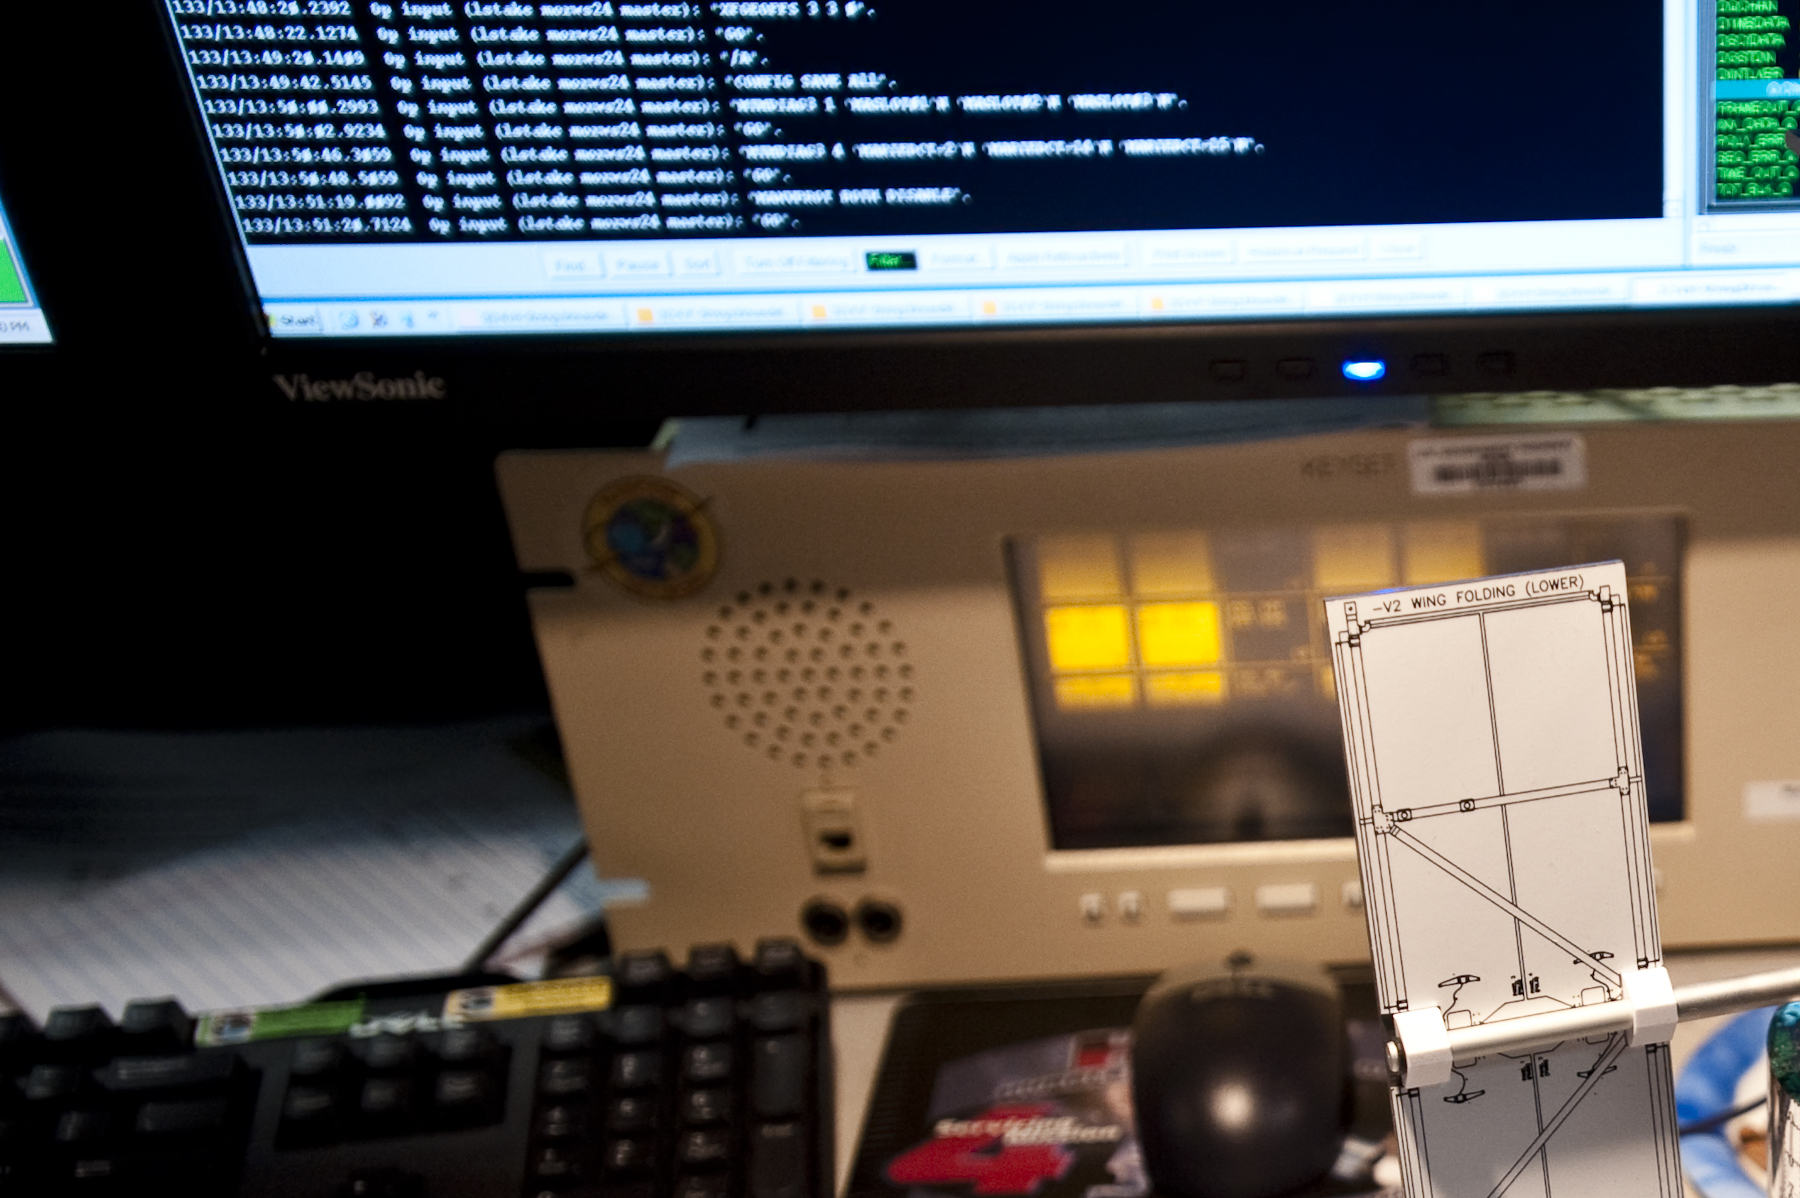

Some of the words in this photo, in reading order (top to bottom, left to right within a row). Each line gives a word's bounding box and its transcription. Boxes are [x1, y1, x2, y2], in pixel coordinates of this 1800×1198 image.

[409, 28, 458, 45] input
[272, 369, 445, 400] ViewSonic
[1411, 593, 1446, 609] WING
[1456, 584, 1515, 603] FOLDING
[1525, 574, 1584, 597] (LOWER)
